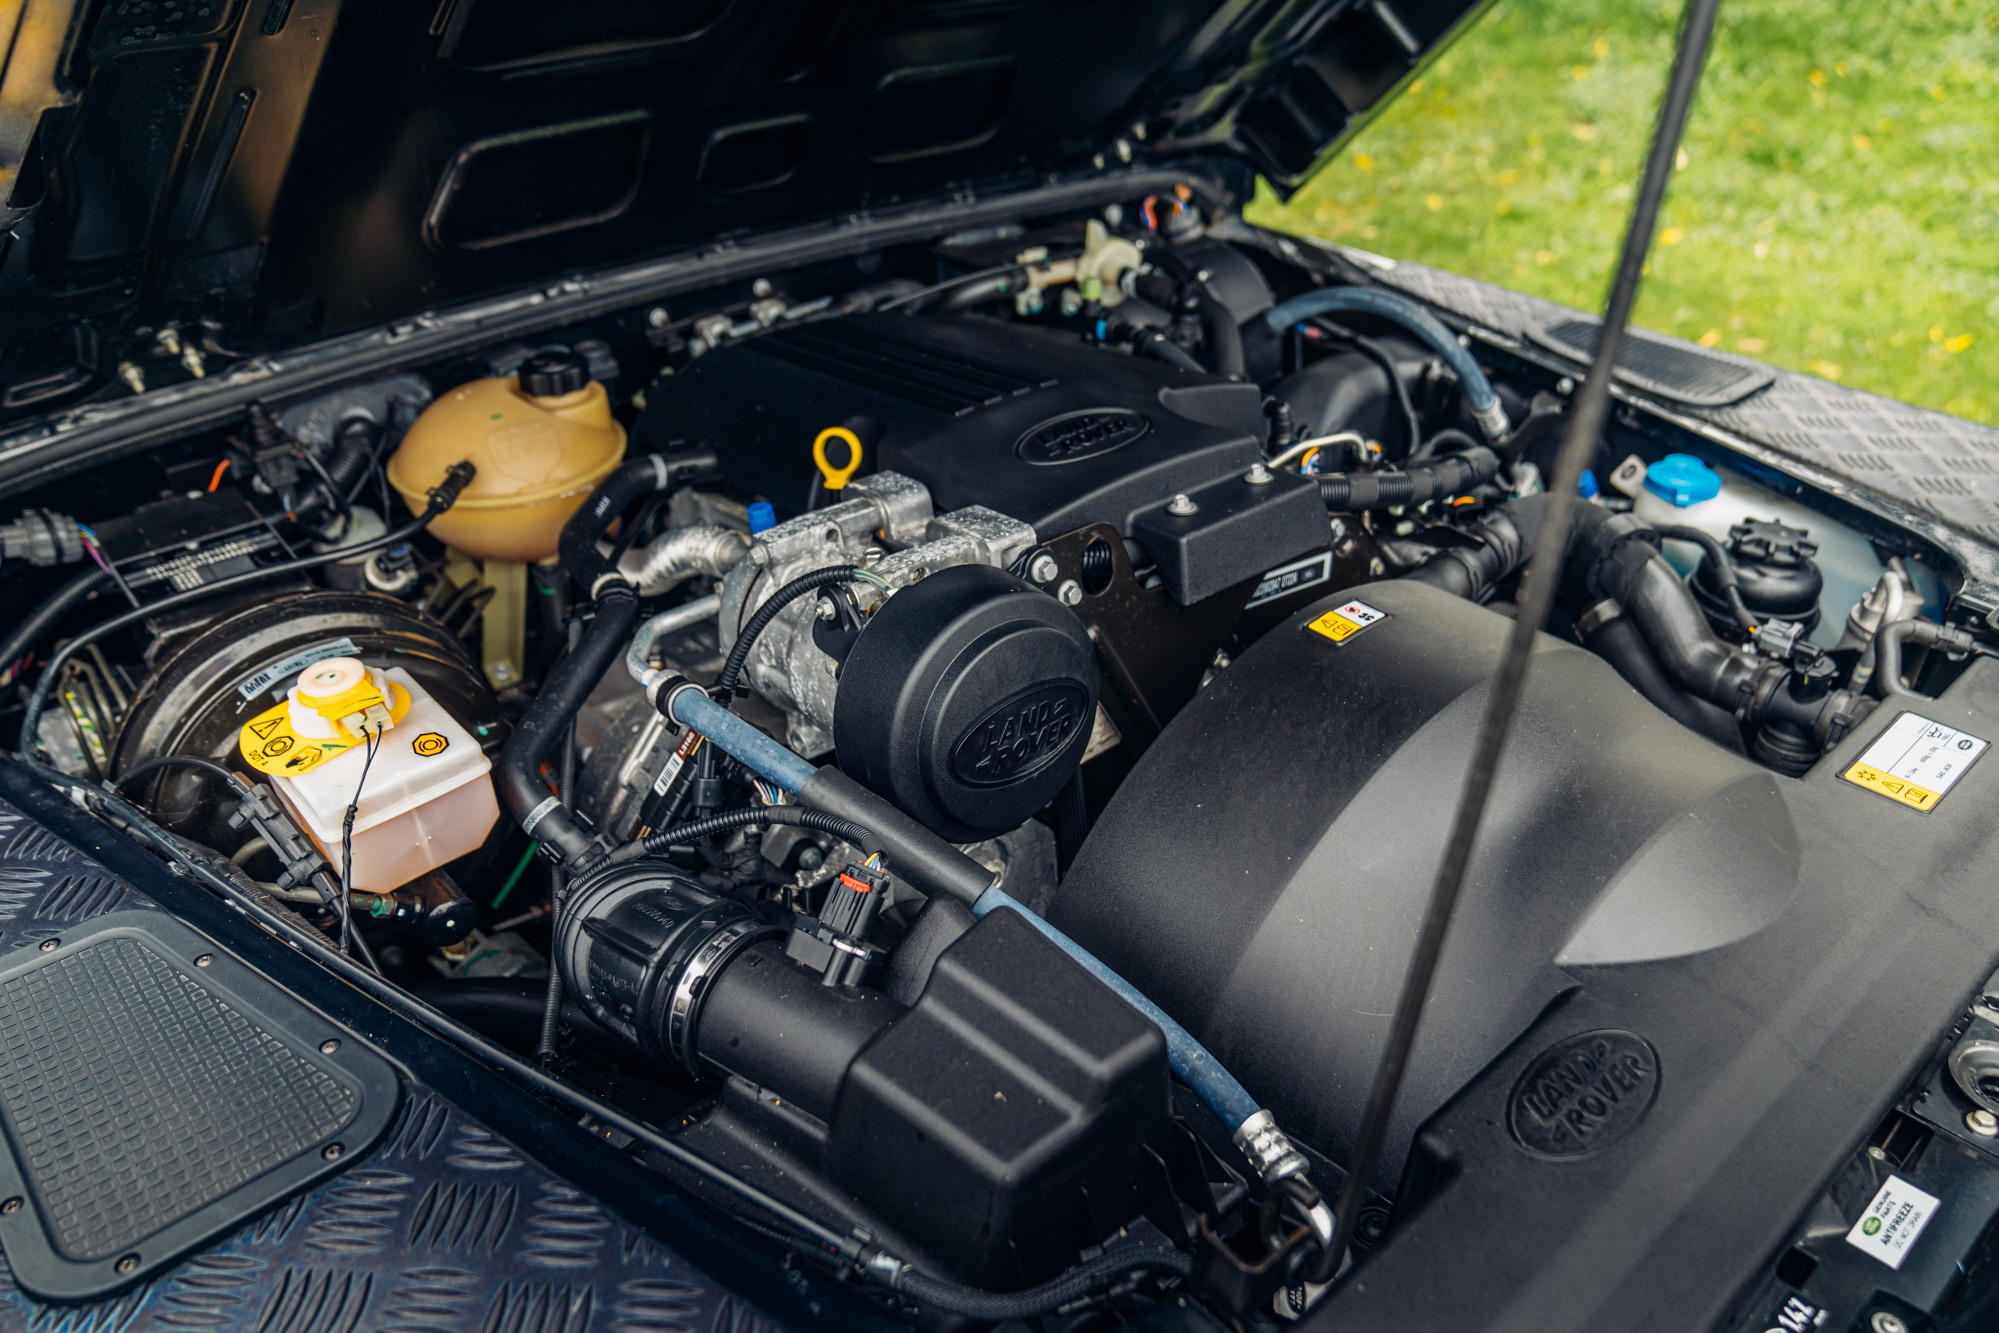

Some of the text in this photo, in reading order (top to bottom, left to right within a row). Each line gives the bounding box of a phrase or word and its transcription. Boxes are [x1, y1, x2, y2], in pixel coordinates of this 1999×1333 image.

[1037, 415, 1098, 447] LAND
[1061, 419, 1136, 455] ROVER
[982, 700, 1050, 752] LAND
[991, 713, 1072, 774] ROVER
[249, 750, 265, 763] DOT
[1522, 1051, 1597, 1128] LAND
[1560, 1053, 1650, 1142] ROVER
[1873, 1190, 1892, 1214] GENUINE
[1880, 1200, 1897, 1219] PARTS
[1880, 1201, 1914, 1246] ANTIFREEZE
